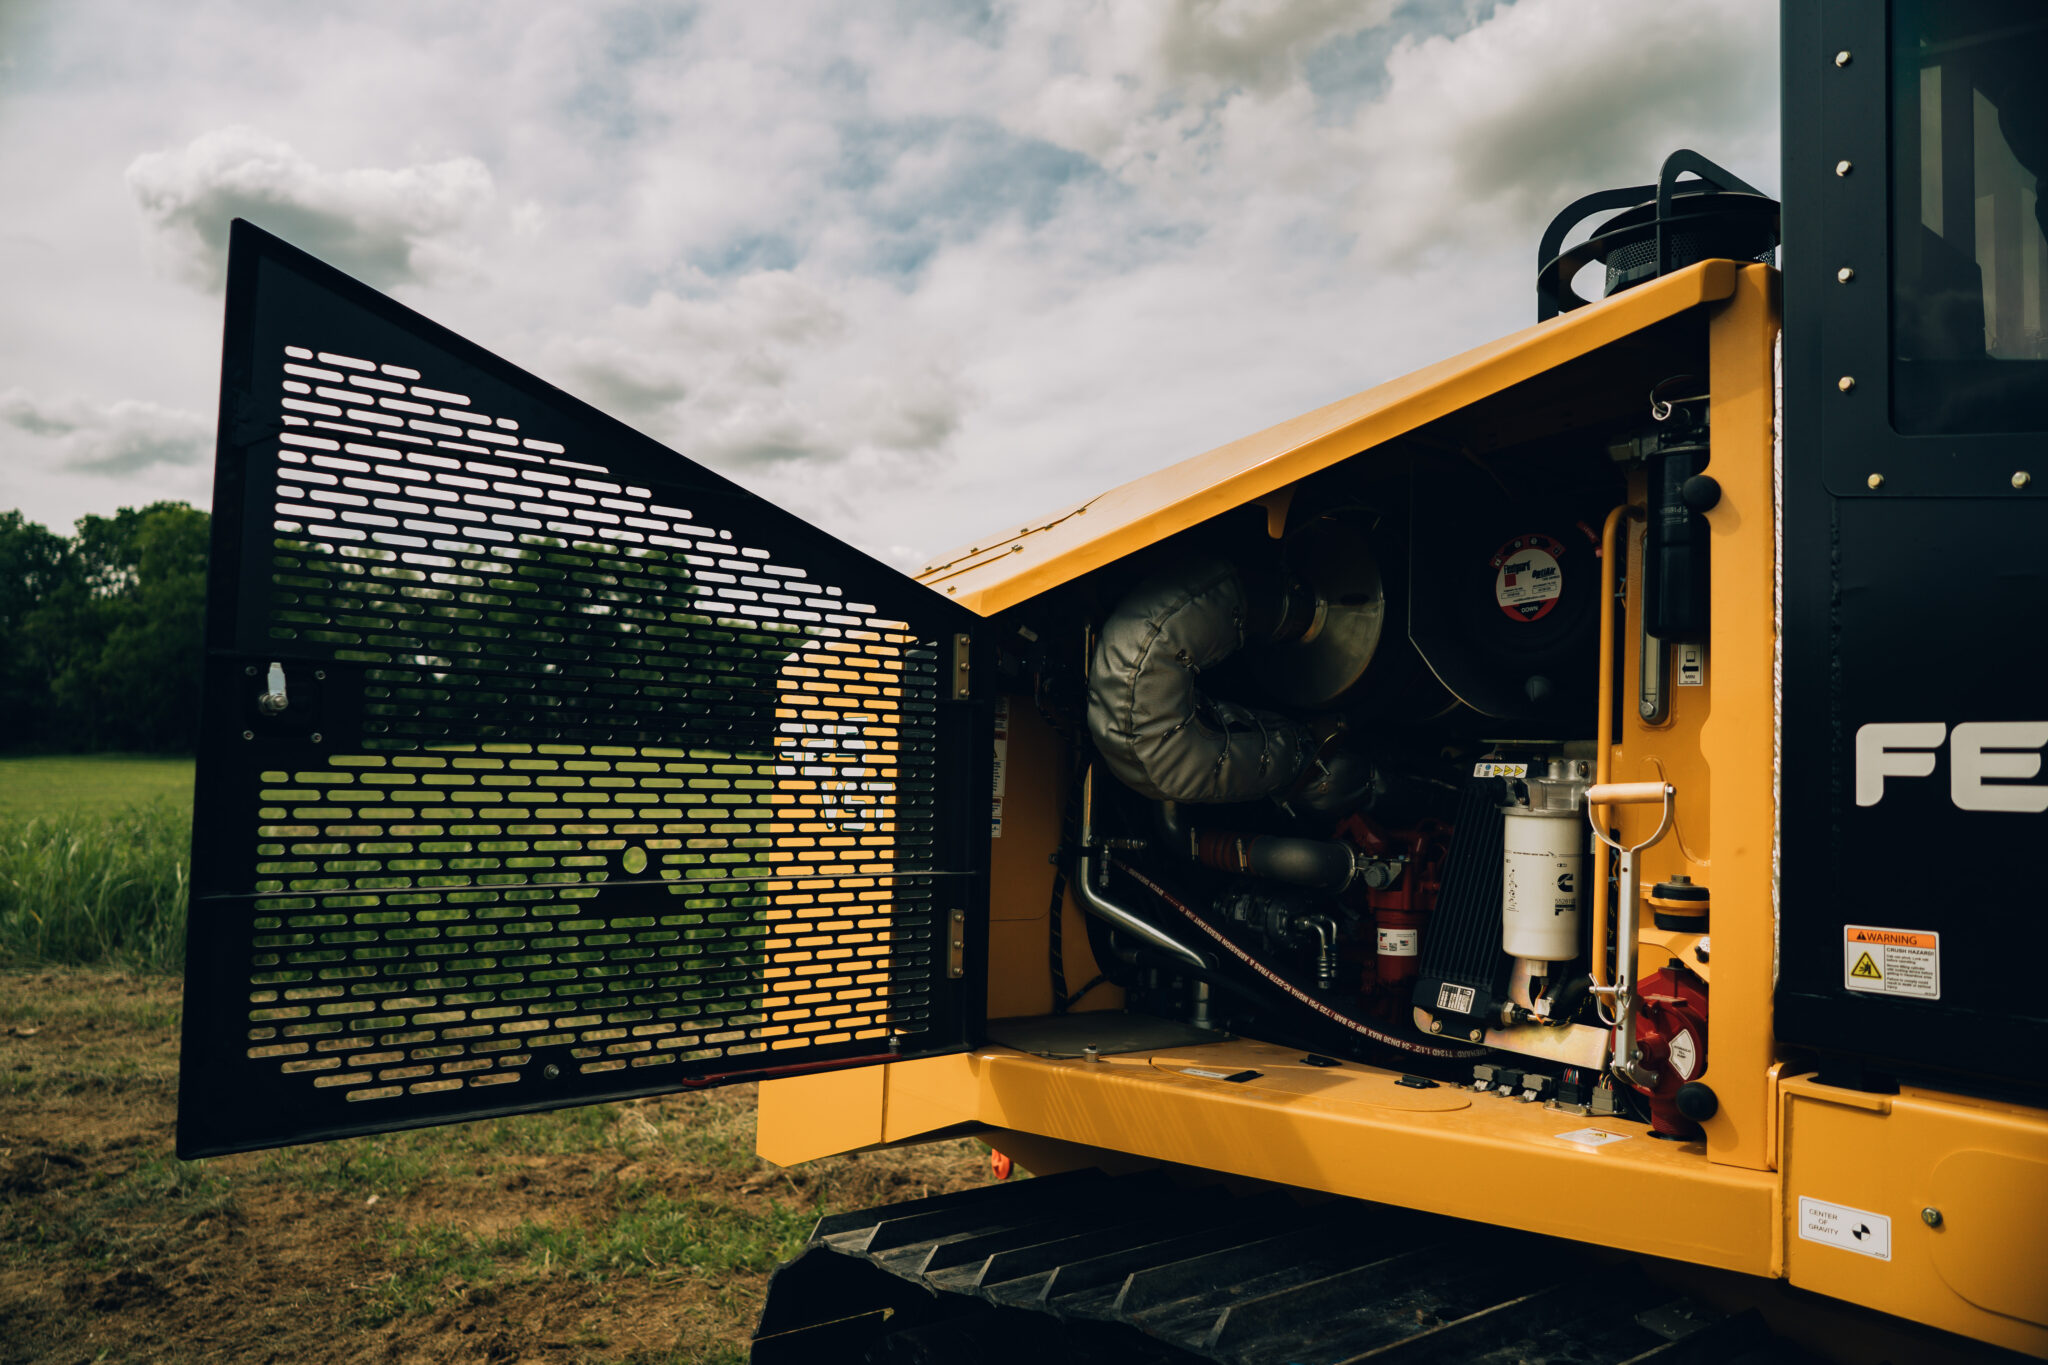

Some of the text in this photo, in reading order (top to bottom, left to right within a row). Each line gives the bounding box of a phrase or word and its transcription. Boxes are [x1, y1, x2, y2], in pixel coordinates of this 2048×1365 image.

[1192, 916, 1223, 942] RESISTANT
[1866, 932, 1918, 945] WARNING
[1222, 938, 1250, 963] ABRASION
[1254, 962, 1270, 978] FRAS
[1291, 988, 1309, 1004] MSHA
[1308, 998, 1319, 1010] PSI
[1319, 1004, 1331, 1016] 725
[1334, 1013, 1348, 1025] BAR
[1348, 1020, 1356, 1030] 50
[1356, 1024, 1368, 1036] WP
[1367, 1030, 1383, 1042] MAX
[1809, 1208, 1838, 1220] CENTER
[1808, 1223, 1838, 1235] GRAVITY
